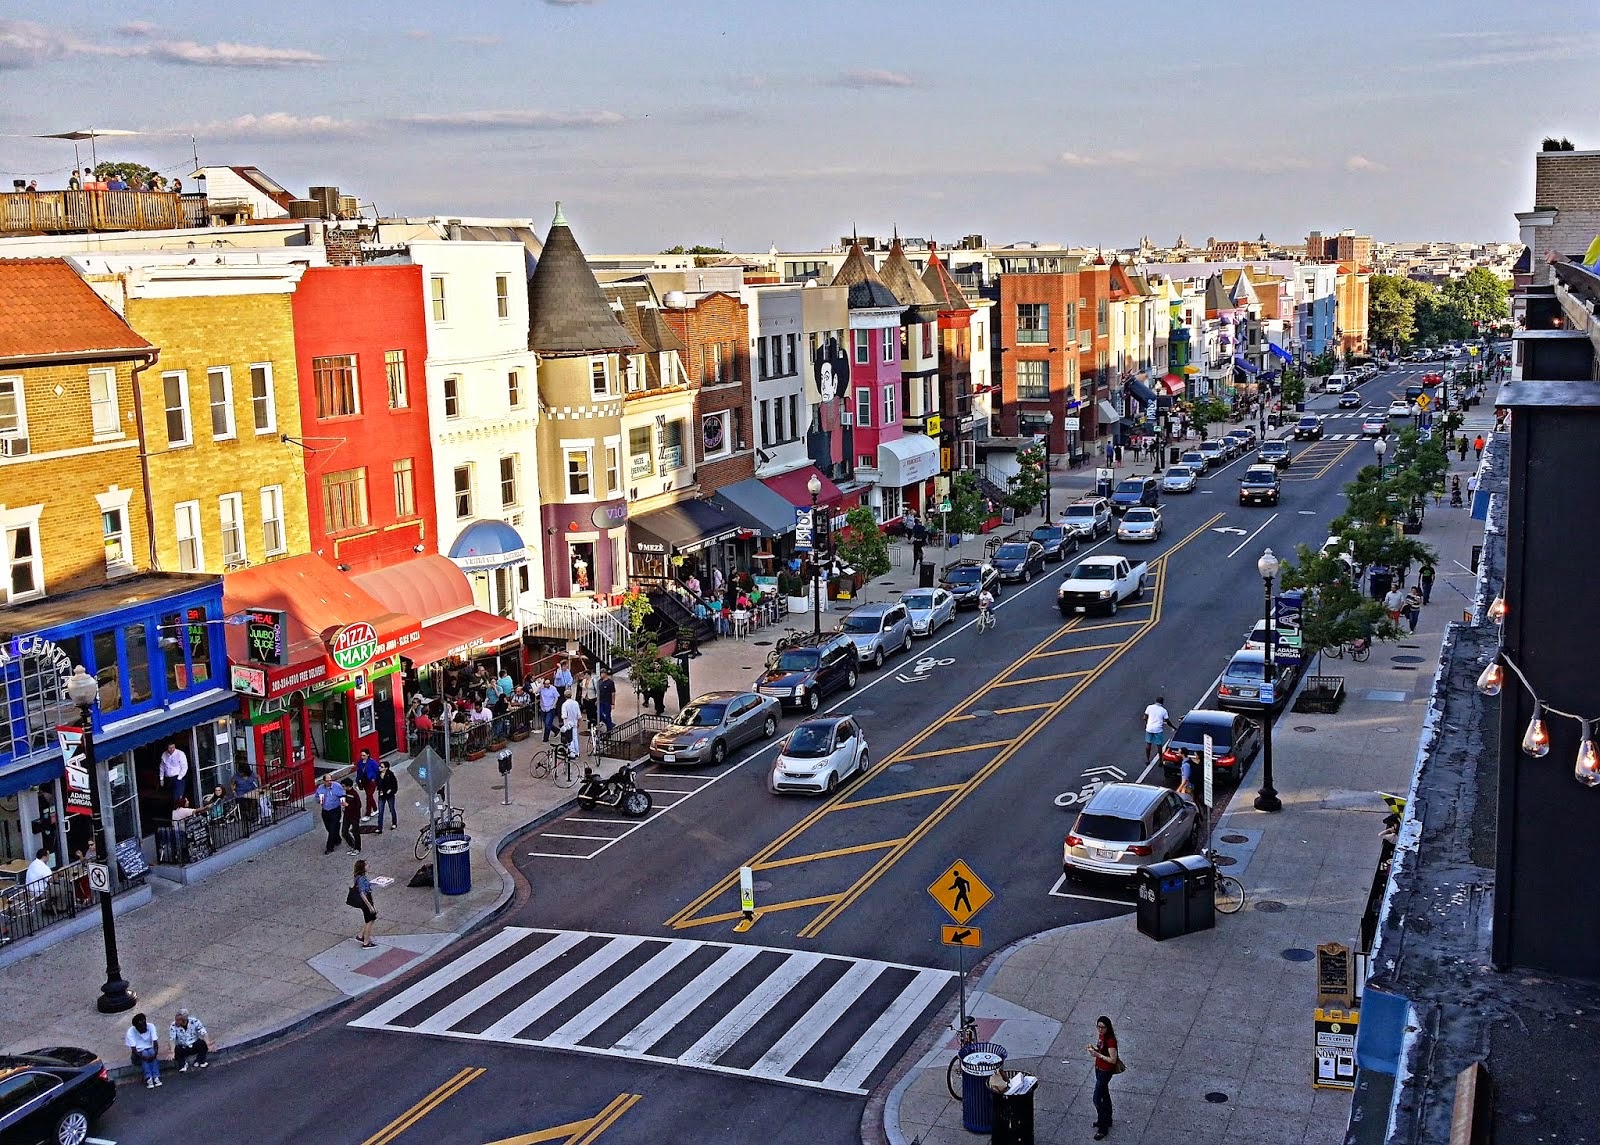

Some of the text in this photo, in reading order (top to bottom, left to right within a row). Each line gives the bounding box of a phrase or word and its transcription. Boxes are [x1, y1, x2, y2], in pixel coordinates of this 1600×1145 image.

[252, 613, 274, 625] REAL
[1278, 601, 1299, 645] PLAY
[250, 630, 274, 640] JUMBO
[340, 625, 374, 649] PIZZA
[254, 639, 274, 649] SLICE
[340, 641, 375, 667] MART
[60, 733, 91, 793] EAT
[67, 798, 92, 806] MORGAN
[70, 792, 91, 800] ADAMS
